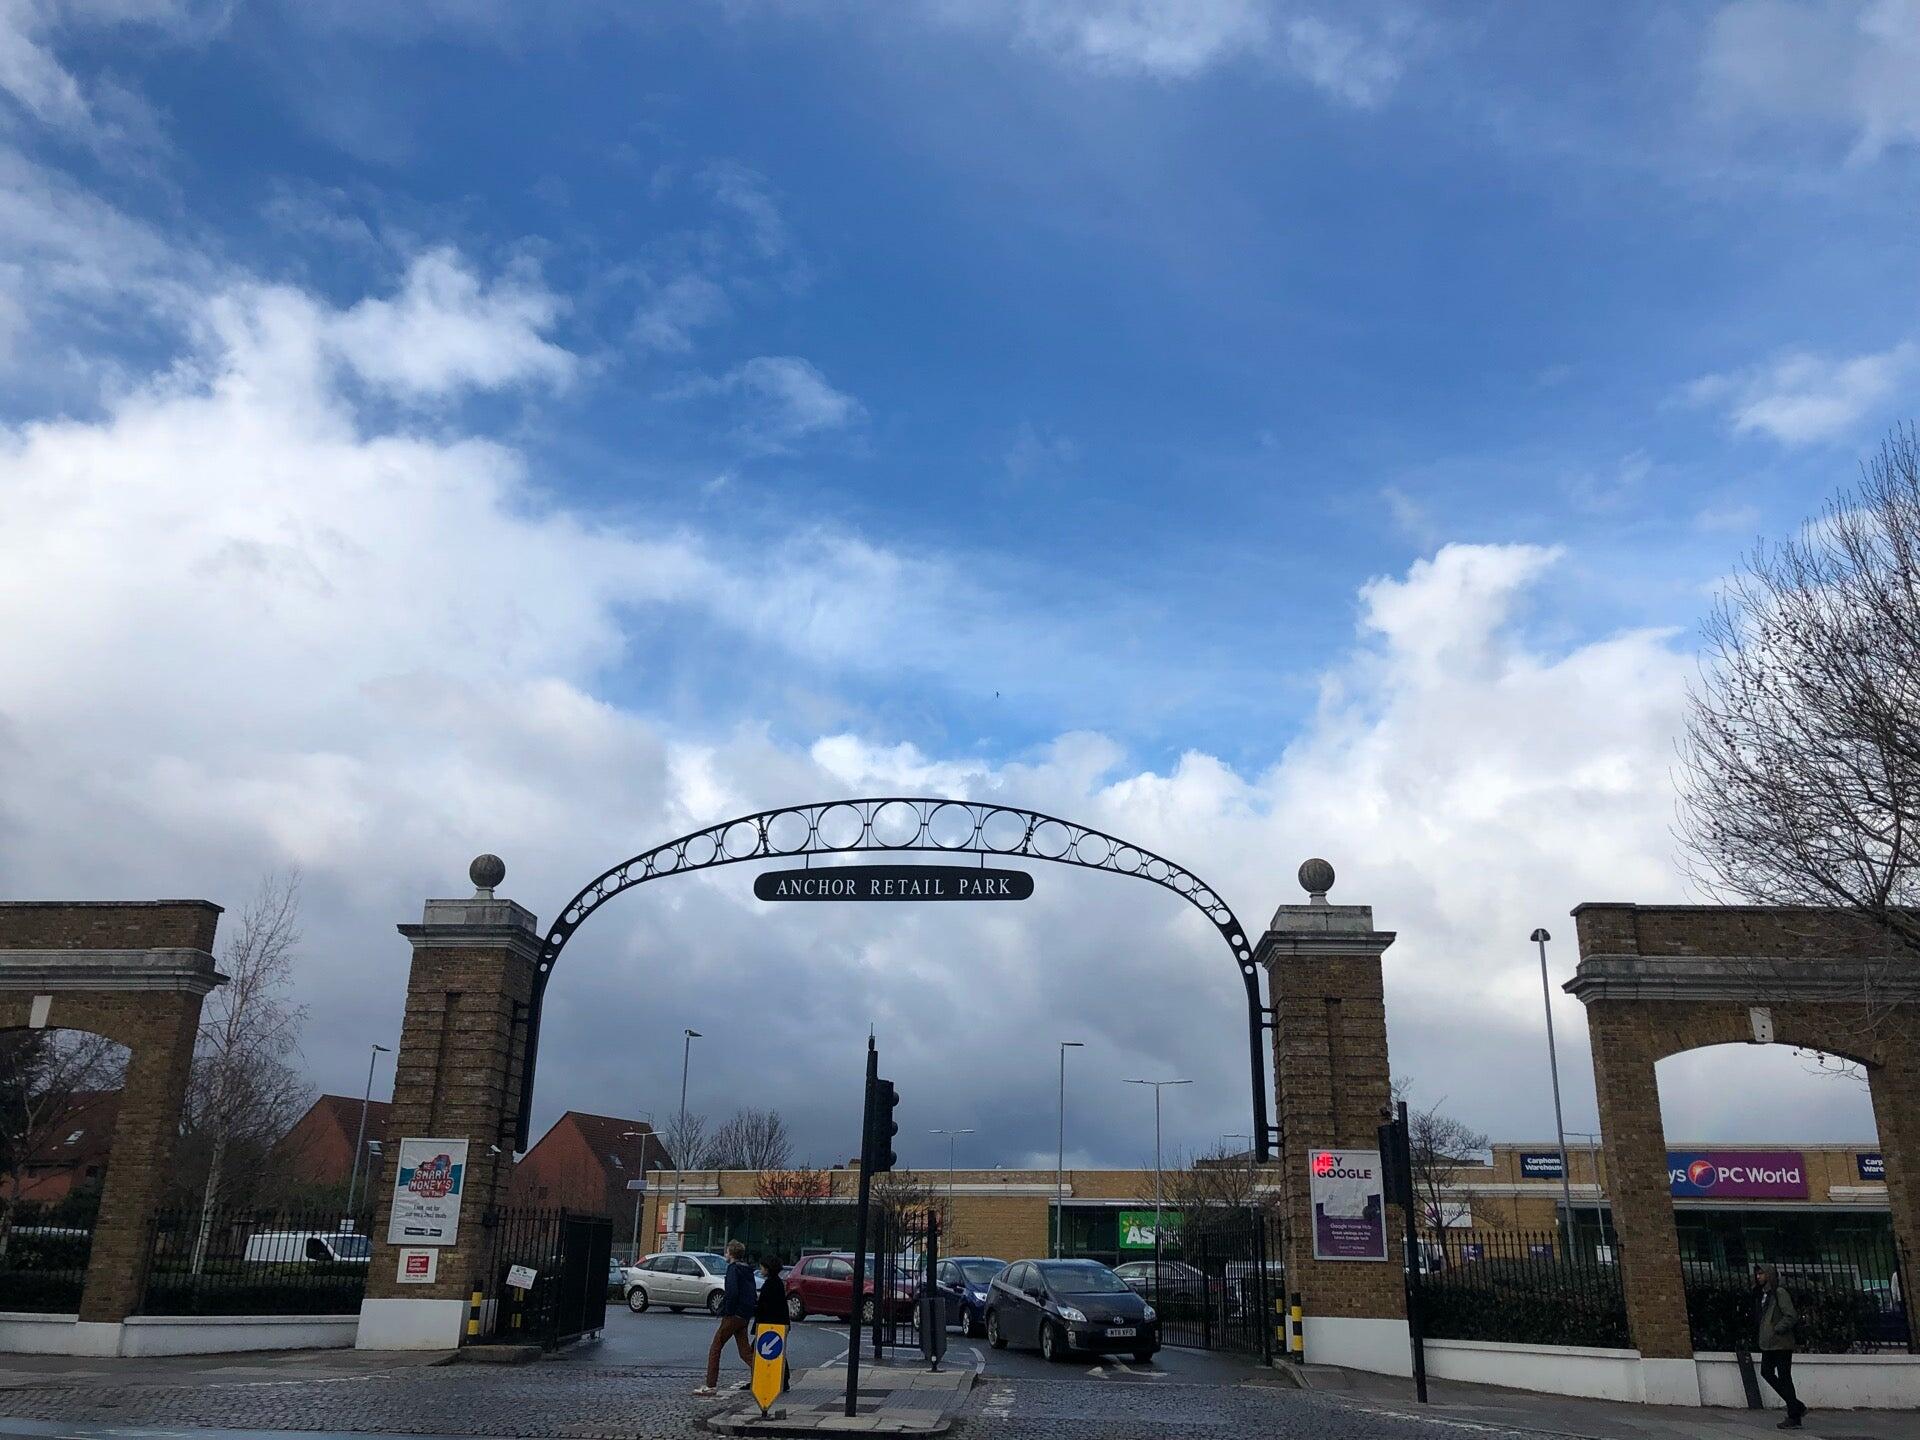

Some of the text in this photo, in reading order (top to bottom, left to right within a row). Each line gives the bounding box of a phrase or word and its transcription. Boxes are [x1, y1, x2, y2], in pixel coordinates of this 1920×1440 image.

[776, 878, 1011, 895] ANCHOR RETAIL PARK
[1316, 1156, 1343, 1167] HEY
[1527, 1157, 1561, 1166] Carphone
[416, 1168, 449, 1180] SMART
[1317, 1168, 1373, 1179] GOOGLE
[1718, 1167, 1745, 1184] PC
[1746, 1167, 1801, 1185] World
[410, 1179, 453, 1191] MONEY'S
